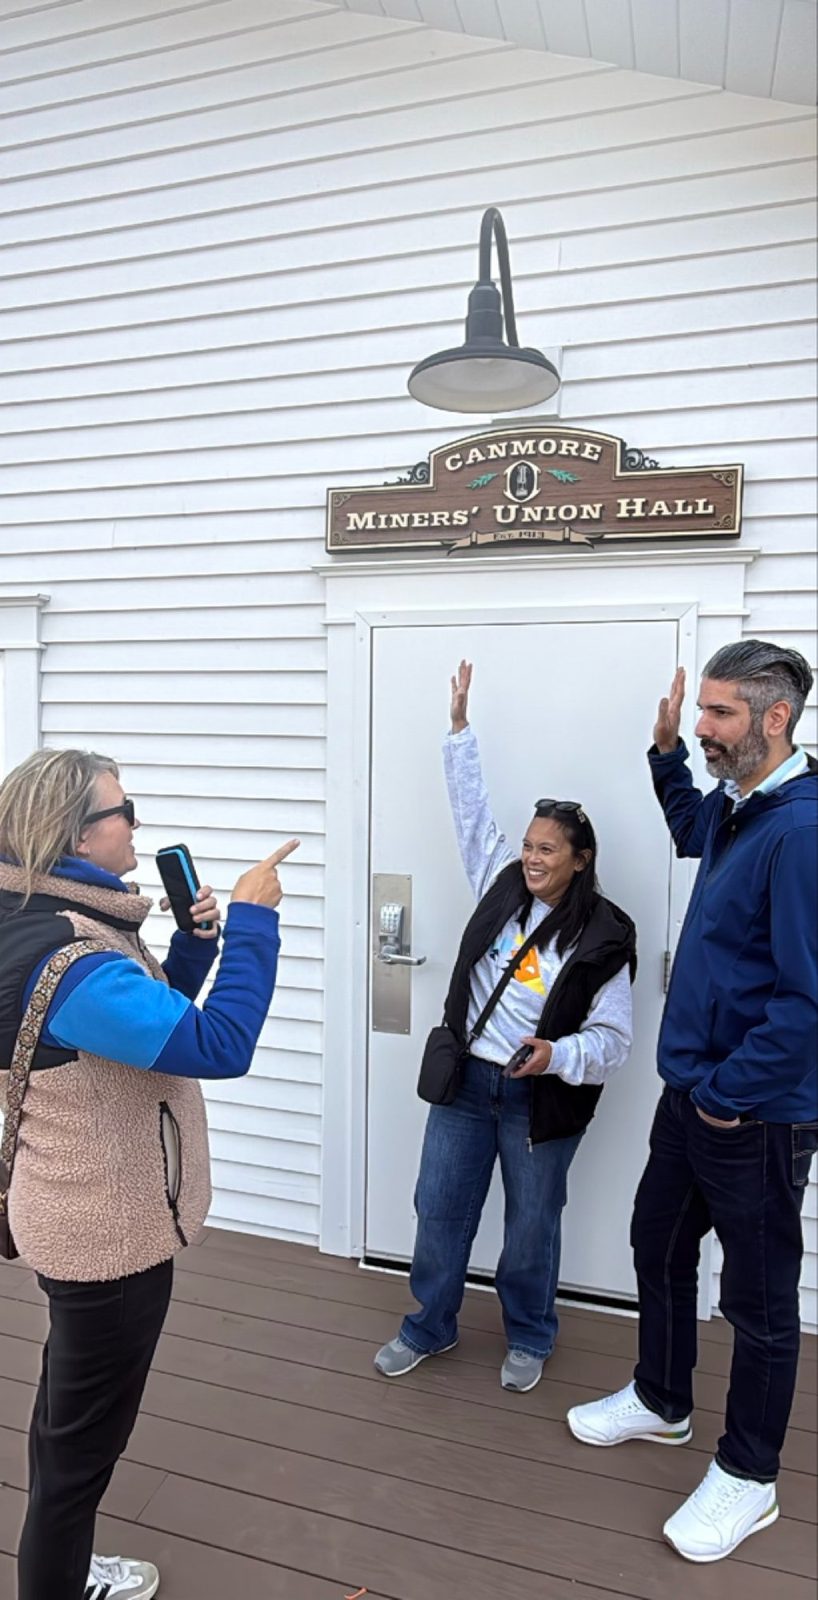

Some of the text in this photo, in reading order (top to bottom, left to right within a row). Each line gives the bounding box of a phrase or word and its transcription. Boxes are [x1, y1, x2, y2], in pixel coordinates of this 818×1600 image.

[445, 438, 603, 471] CANMORE
[493, 502, 603, 524] UNION
[616, 497, 715, 518] HALL
